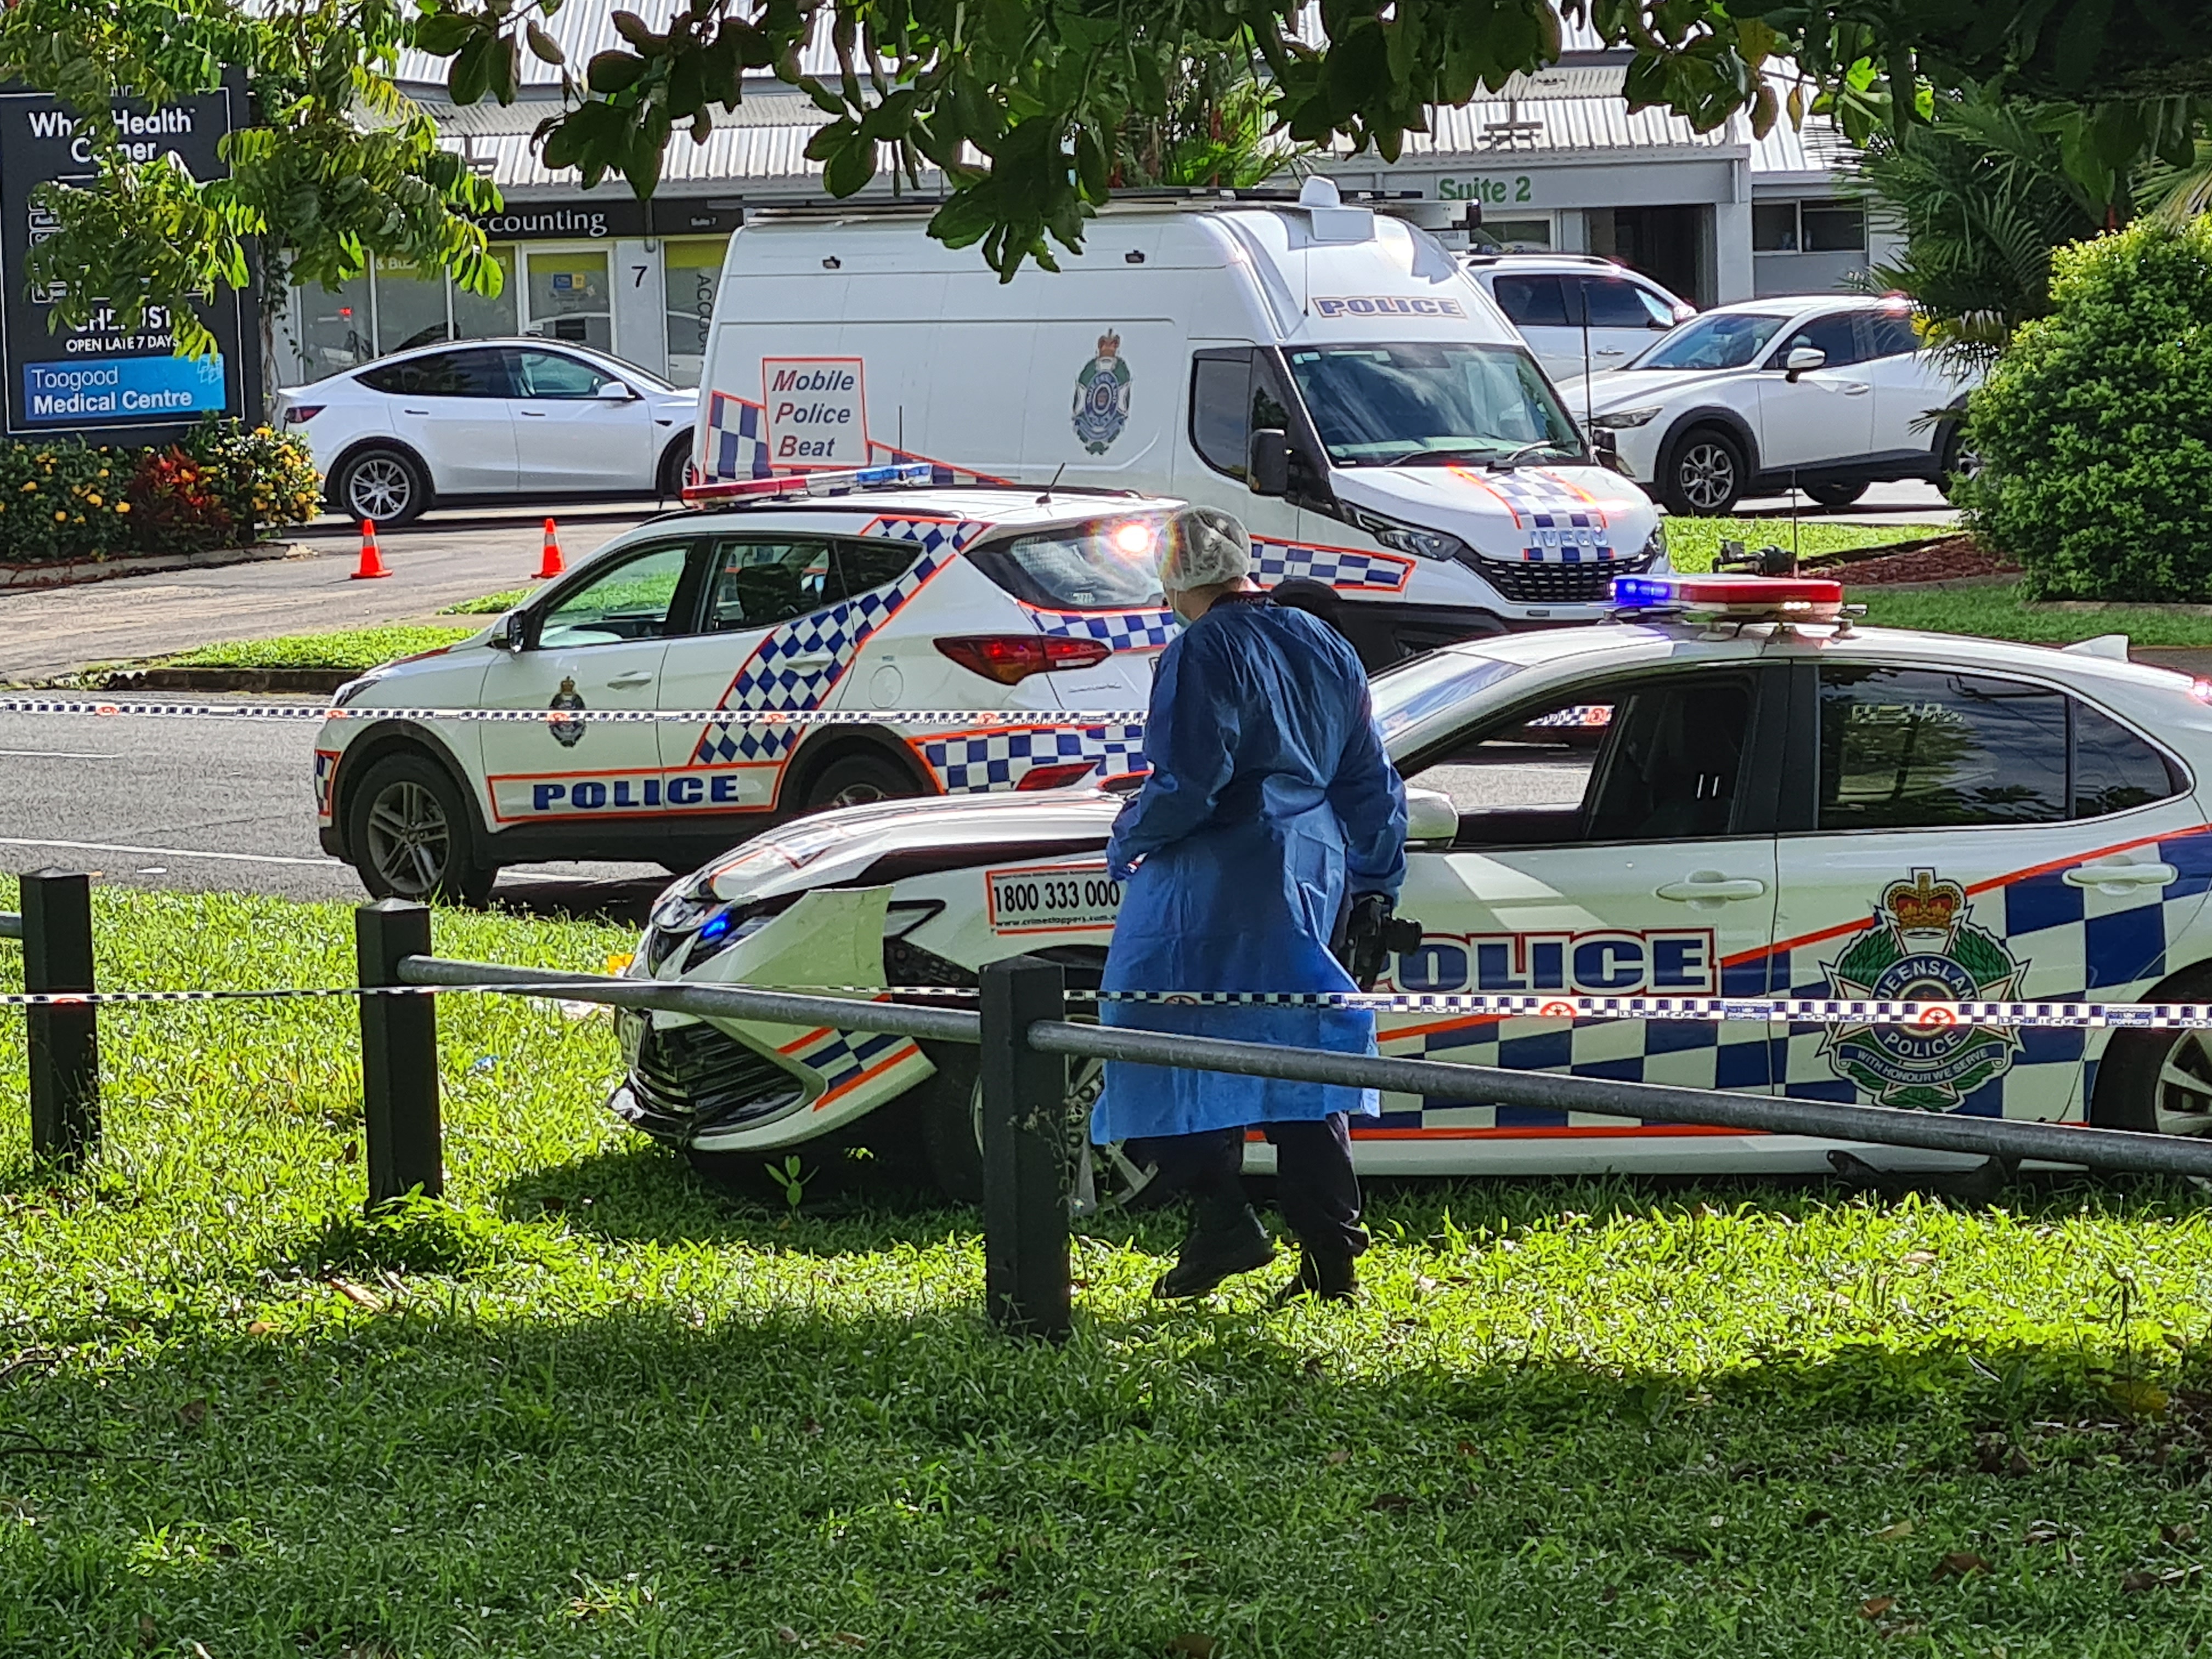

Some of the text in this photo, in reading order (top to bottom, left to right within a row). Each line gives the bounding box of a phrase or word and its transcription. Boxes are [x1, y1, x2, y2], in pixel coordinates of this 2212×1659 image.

[111, 108, 191, 134] Health
[71, 137, 157, 163] Cner
[1439, 176, 1531, 204] Suite 2
[631, 266, 648, 288] 7
[1318, 298, 1462, 315] POLICE
[65, 338, 102, 353] OPEN
[137, 336, 145, 349] 7
[31, 365, 119, 392] Toogood
[771, 370, 855, 392] Mobile
[32, 390, 193, 415] Medical Centre
[775, 402, 851, 424] Police
[778, 435, 836, 457] Beat
[533, 775, 739, 811] POLICE
[993, 879, 1121, 913] 1800 333 000
[1378, 939, 1707, 992] OLICE
[1877, 960, 1975, 1001] UEENSLAN
[1884, 1030, 1961, 1057] POLICE
[1857, 1047, 1989, 1082] WITH HONOUR WE SERVE
